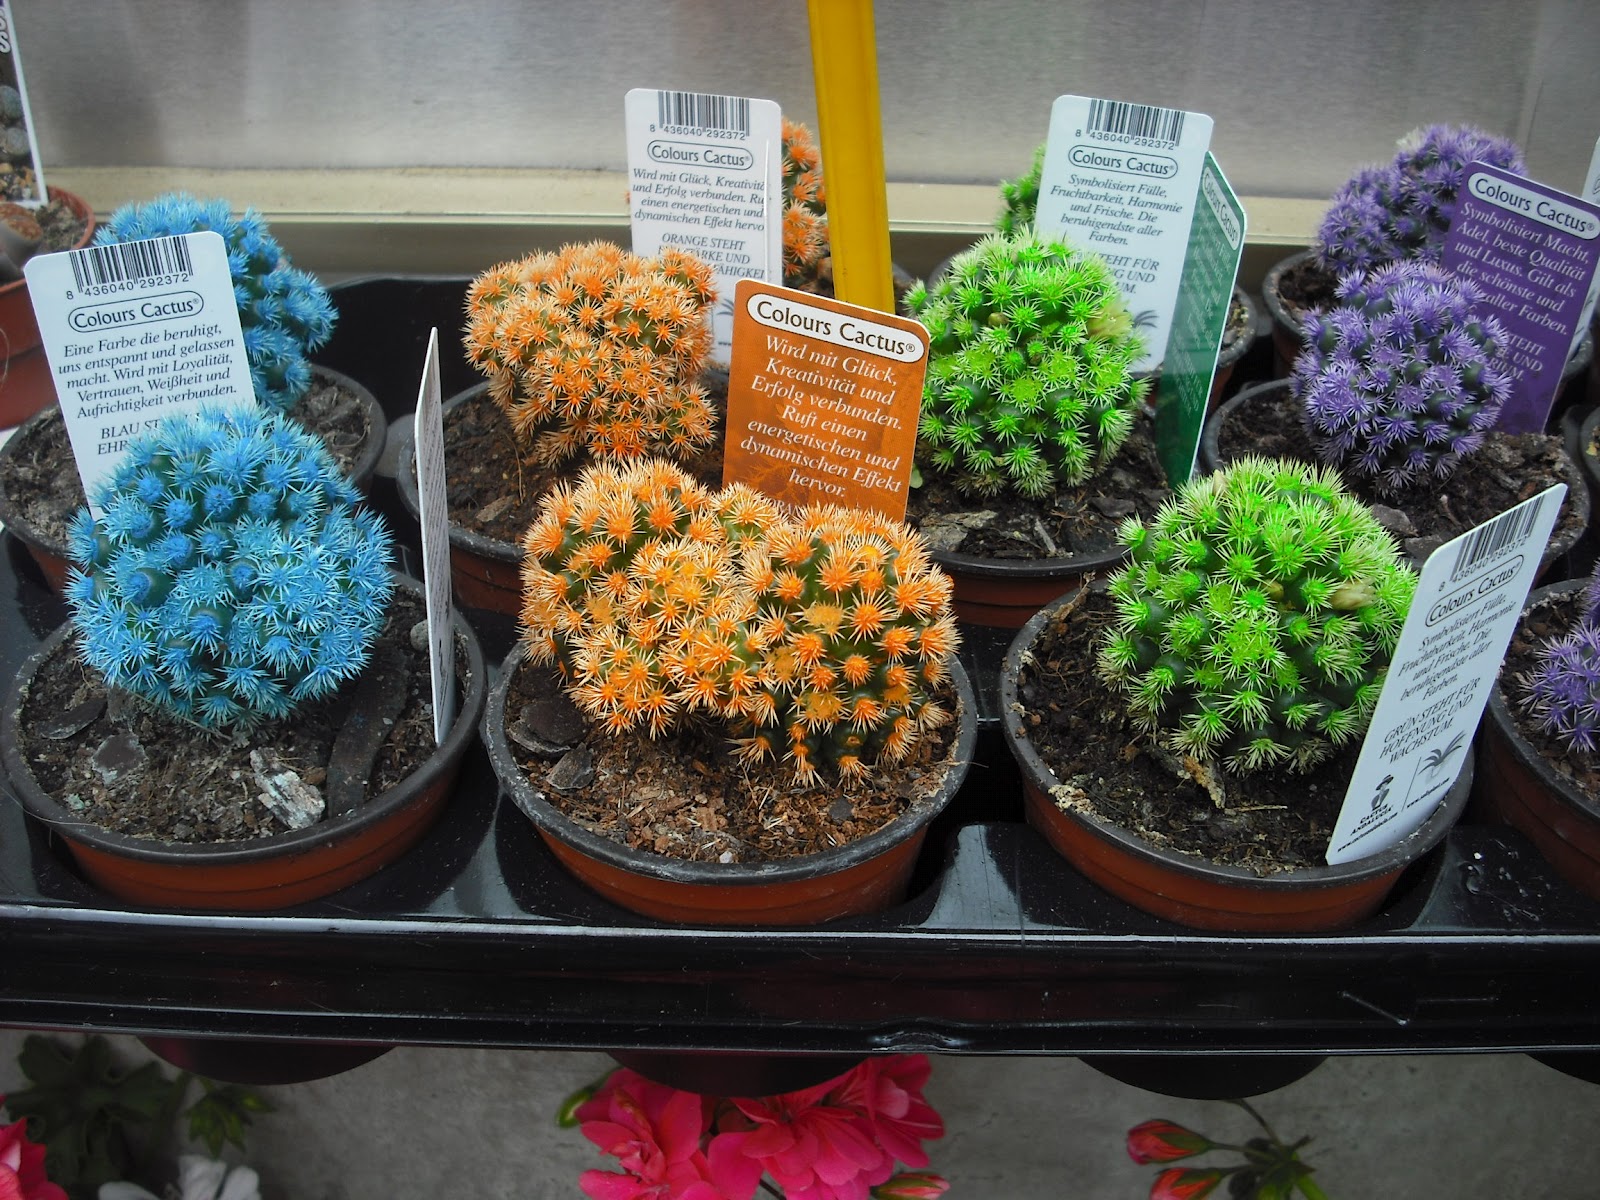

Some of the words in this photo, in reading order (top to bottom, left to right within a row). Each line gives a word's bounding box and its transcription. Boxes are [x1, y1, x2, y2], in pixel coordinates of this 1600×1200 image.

[650, 124, 656, 132] 8
[664, 126, 702, 136] 436040
[707, 129, 746, 141] 292372
[1076, 129, 1081, 137] 8
[1090, 132, 1130, 143] 436040
[1134, 137, 1175, 150] 292372
[652, 145, 698, 162] Colours
[1073, 150, 1121, 168] Colours
[633, 168, 657, 180] Wird
[660, 172, 675, 182] mit
[679, 173, 711, 186] Glück,
[633, 183, 652, 193] und
[655, 184, 687, 198] Erfolg
[690, 188, 746, 202] verbunden.
[1068, 174, 1136, 193] Symbolisiert
[1139, 185, 1167, 198] Fülle,
[641, 198, 668, 208] einen
[671, 199, 741, 216] energetischen
[744, 206, 765, 218] und
[1128, 196, 1182, 213] Harmonie
[1475, 178, 1531, 211] Colours
[635, 211, 700, 225] dynamischen
[704, 217, 732, 229] Effekt
[1061, 214, 1135, 233] beruhigendste
[1137, 226, 1163, 237] aller
[1070, 204, 1091, 214] und
[1093, 205, 1134, 220] Frische.
[1140, 212, 1158, 222] Die
[662, 232, 707, 248] ORANGE
[710, 237, 746, 251] STEHT
[1089, 232, 1128, 245] Farben.
[1461, 202, 1541, 244] Symbolisiert
[1545, 235, 1589, 264] Macht,
[725, 252, 750, 264] UND
[1133, 258, 1160, 271] FÜR
[1457, 222, 1489, 244] Adel,
[1493, 235, 1527, 257] beste
[1529, 250, 1586, 281] Qualität
[66, 290, 73, 299] 8
[84, 281, 134, 297] 436040
[140, 273, 189, 289] 292372
[1127, 272, 1155, 282] UND
[1455, 243, 1481, 260] und
[1482, 250, 1522, 277] Luxus.
[1527, 270, 1554, 290] Gilt
[1555, 281, 1577, 297] als
[1457, 261, 1478, 277] die
[1481, 270, 1535, 300] schönste
[1536, 295, 1564, 313] und
[74, 309, 135, 328] Colours
[757, 301, 832, 336] Colours
[1519, 305, 1567, 335] Farben.
[59, 363, 81, 374] uns
[85, 353, 148, 373] entspannt
[152, 344, 176, 359] und
[180, 338, 234, 358] gelassen
[64, 345, 93, 357] Eine
[98, 335, 136, 352] Farbe
[140, 333, 159, 344] die
[164, 324, 222, 342] beruhigt,
[67, 376, 110, 389] macht.
[114, 365, 144, 381] Wird
[148, 362, 169, 376] mit
[173, 353, 232, 375] Loyalität,
[767, 335, 806, 360] Wird
[809, 351, 839, 368] mit
[842, 357, 898, 386] Glück,
[1513, 352, 1543, 372] UND
[77, 384, 143, 402] Vertrauen,
[148, 373, 202, 392] Weißheit
[206, 369, 230, 381] und
[766, 358, 856, 395] Kreativität
[860, 388, 896, 405] und
[77, 395, 163, 418] Aufrichtigkeit
[168, 385, 237, 403] verbunden.
[751, 375, 804, 405] Erfolg
[810, 394, 902, 430] verbunden.
[102, 422, 139, 439] BLAU
[782, 405, 817, 427] Ruft
[821, 420, 867, 441] einen
[748, 420, 860, 460] energetischen
[866, 452, 900, 471] und
[740, 437, 848, 477] dynamischen
[853, 468, 902, 493] Effekt
[789, 469, 845, 497] hervor.
[1439, 582, 1445, 591] 8
[1452, 562, 1487, 583] 436040
[1491, 540, 1526, 563] 292372
[1430, 588, 1475, 622] Colours
[1468, 602, 1517, 636] Harmonie
[1419, 610, 1479, 651] Symbolisiert
[1480, 593, 1506, 619] Fülle,
[1400, 652, 1469, 701] beruhigendste
[1469, 641, 1492, 658] aller
[1412, 664, 1432, 681] und
[1473, 629, 1492, 645] Die
[1422, 674, 1458, 700] Farben.
[1379, 709, 1449, 759] HOFFNUNG
[1449, 693, 1473, 716] UND
[1384, 714, 1421, 743] GRÜN
[1421, 692, 1457, 719] STEHT
[1457, 677, 1481, 701] FÜR
[1390, 718, 1453, 764] WACHSTUM.
